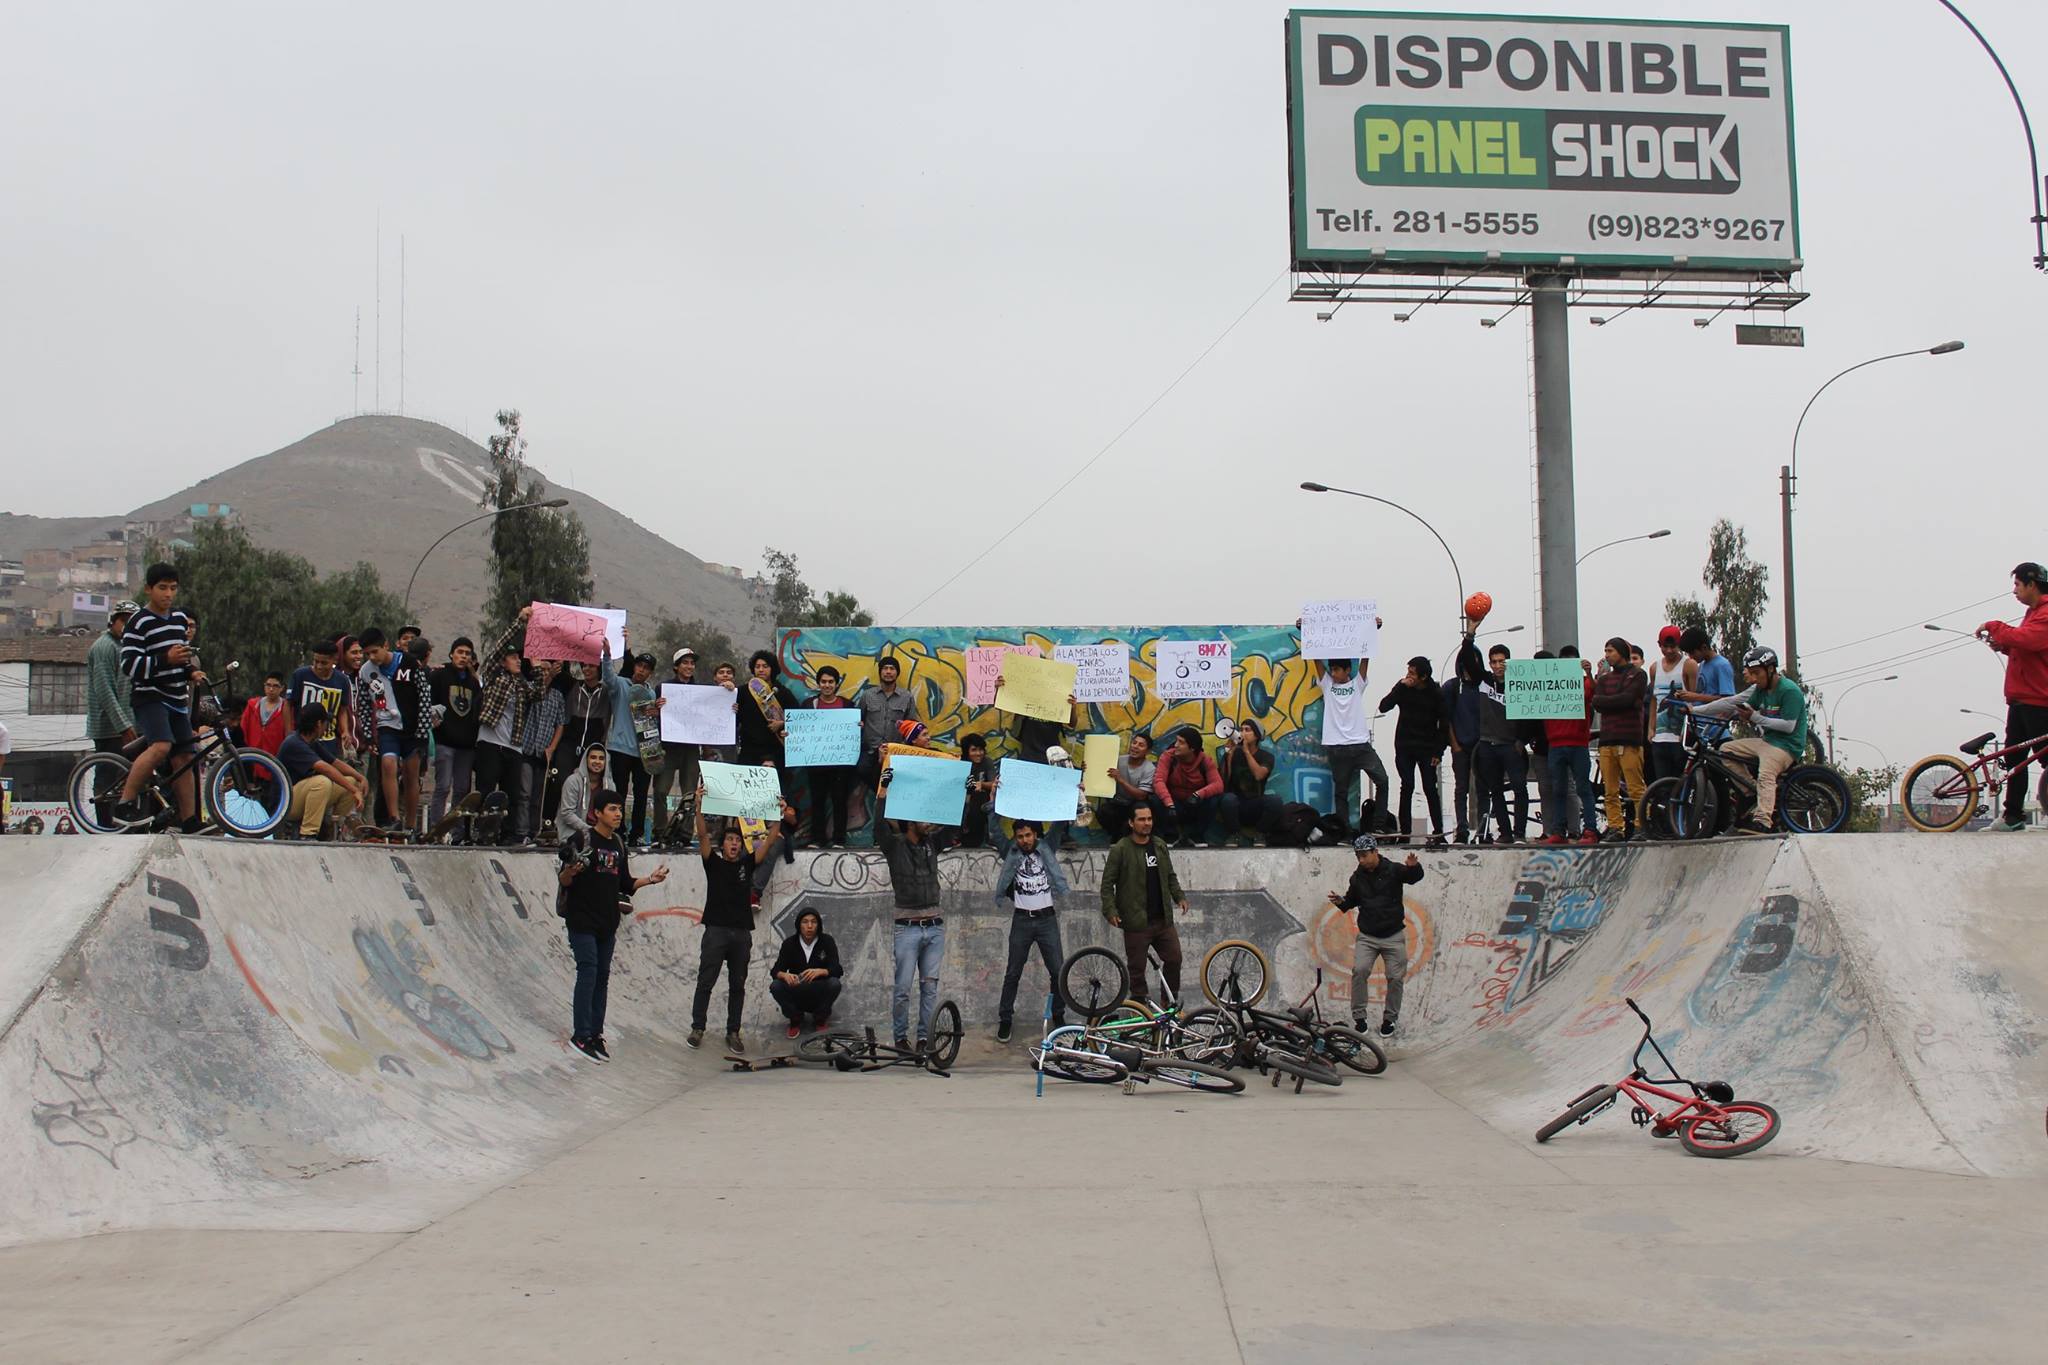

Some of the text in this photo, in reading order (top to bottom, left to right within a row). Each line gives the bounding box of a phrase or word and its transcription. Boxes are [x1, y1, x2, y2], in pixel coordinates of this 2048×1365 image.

[1317, 33, 1771, 99] DISPONIBLE
[1365, 114, 1740, 182] PANEL SHOCK
[1316, 208, 1382, 233] Telf.
[1392, 210, 1540, 236] 281-5555
[1198, 643, 1228, 657] BMX
[1509, 664, 1526, 677] NO
[1545, 662, 1560, 676] LA
